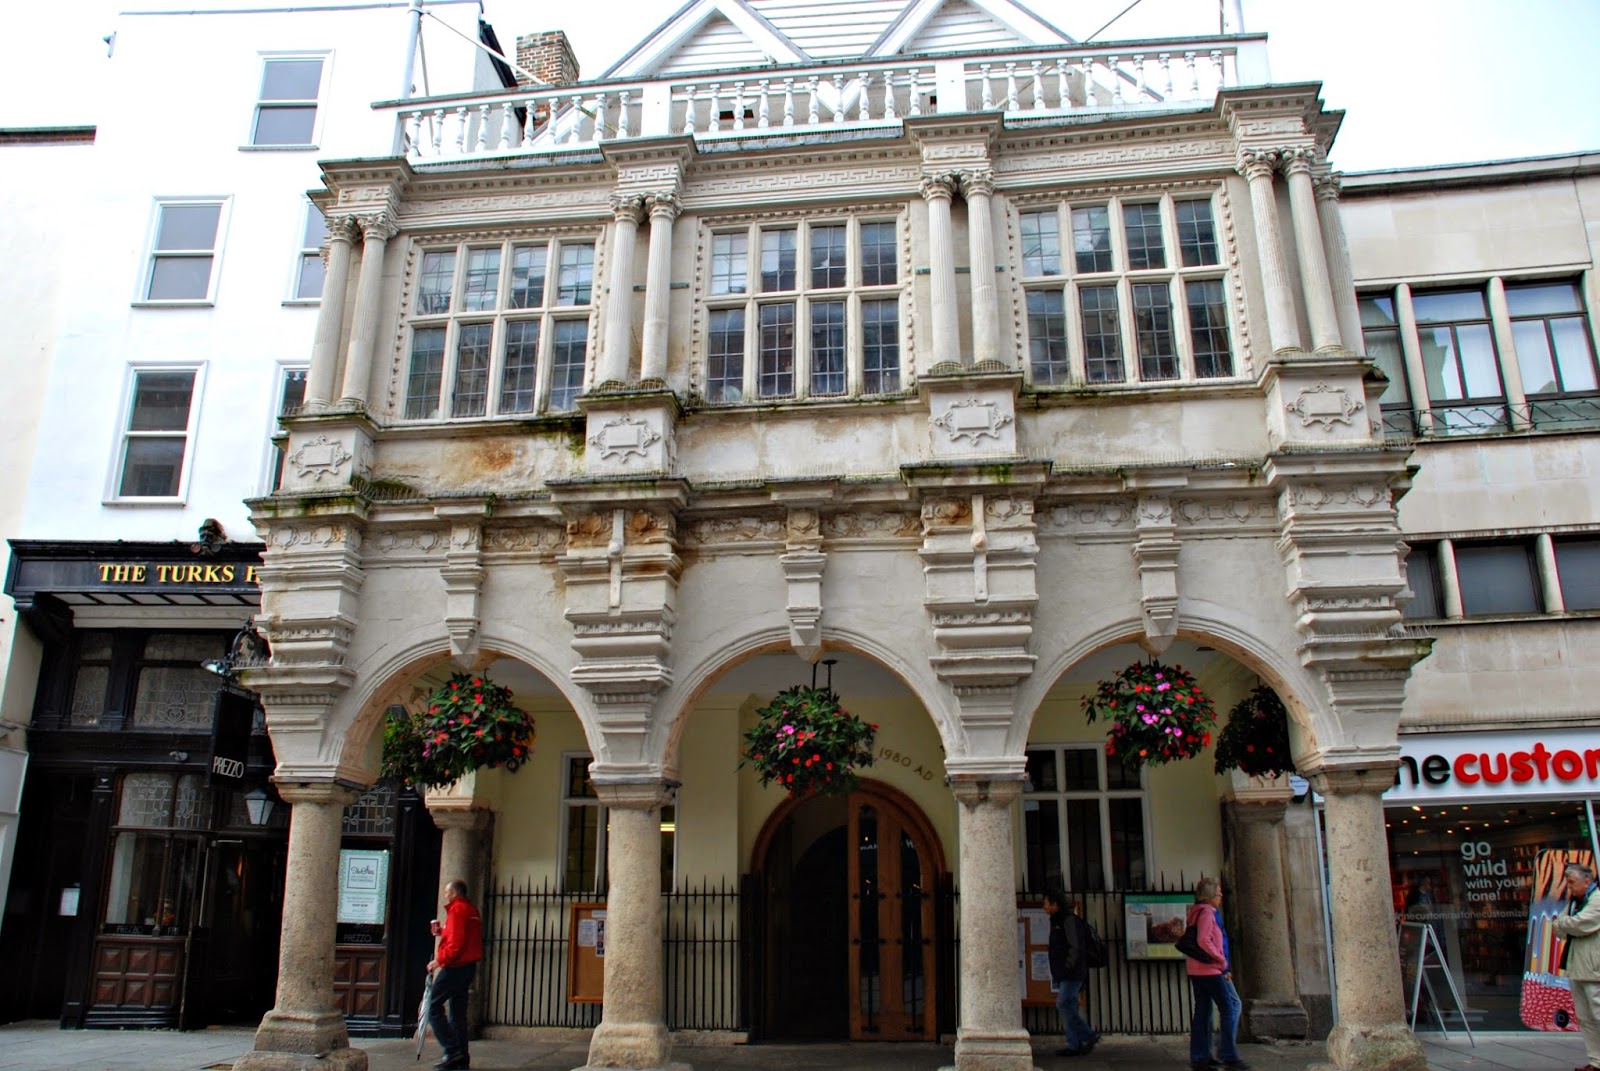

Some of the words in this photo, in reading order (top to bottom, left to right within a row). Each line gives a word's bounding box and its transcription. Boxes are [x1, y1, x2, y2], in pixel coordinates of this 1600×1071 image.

[99, 564, 147, 583] THE
[157, 564, 235, 583] TURKS
[212, 755, 245, 779] PREZZO
[880, 747, 912, 768] 1980
[913, 765, 934, 781] AD
[1460, 841, 1492, 860] go
[1463, 859, 1508, 877] wild
[1465, 878, 1493, 889] with
[1467, 890, 1501, 902] fone!
[343, 933, 373, 943] PREZZO
